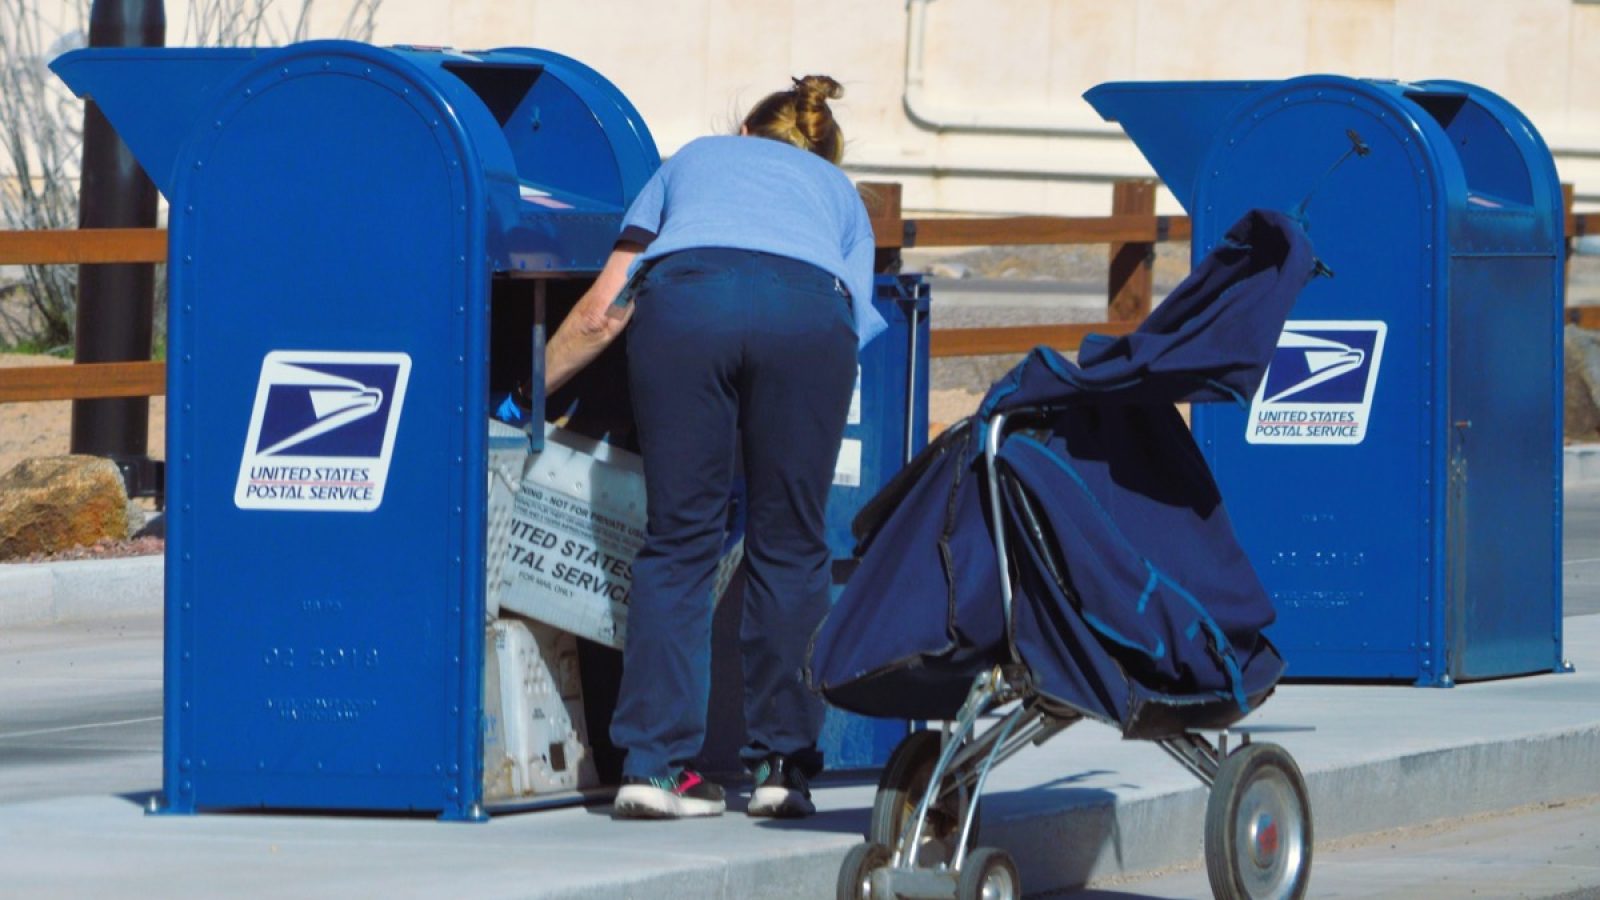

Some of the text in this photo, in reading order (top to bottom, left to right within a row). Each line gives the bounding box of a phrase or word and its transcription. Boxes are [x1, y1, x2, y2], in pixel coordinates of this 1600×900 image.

[1258, 411, 1355, 422] UNITED STATES
[1255, 425, 1359, 437] POSTAL SERVICE
[250, 466, 370, 482] UNITED STATES
[246, 485, 375, 501] POSTAL SERVICE
[521, 485, 543, 500] NING
[549, 496, 568, 510] NOT
[569, 503, 589, 518] FOR
[511, 518, 557, 551] ITED
[508, 542, 545, 573] TAL
